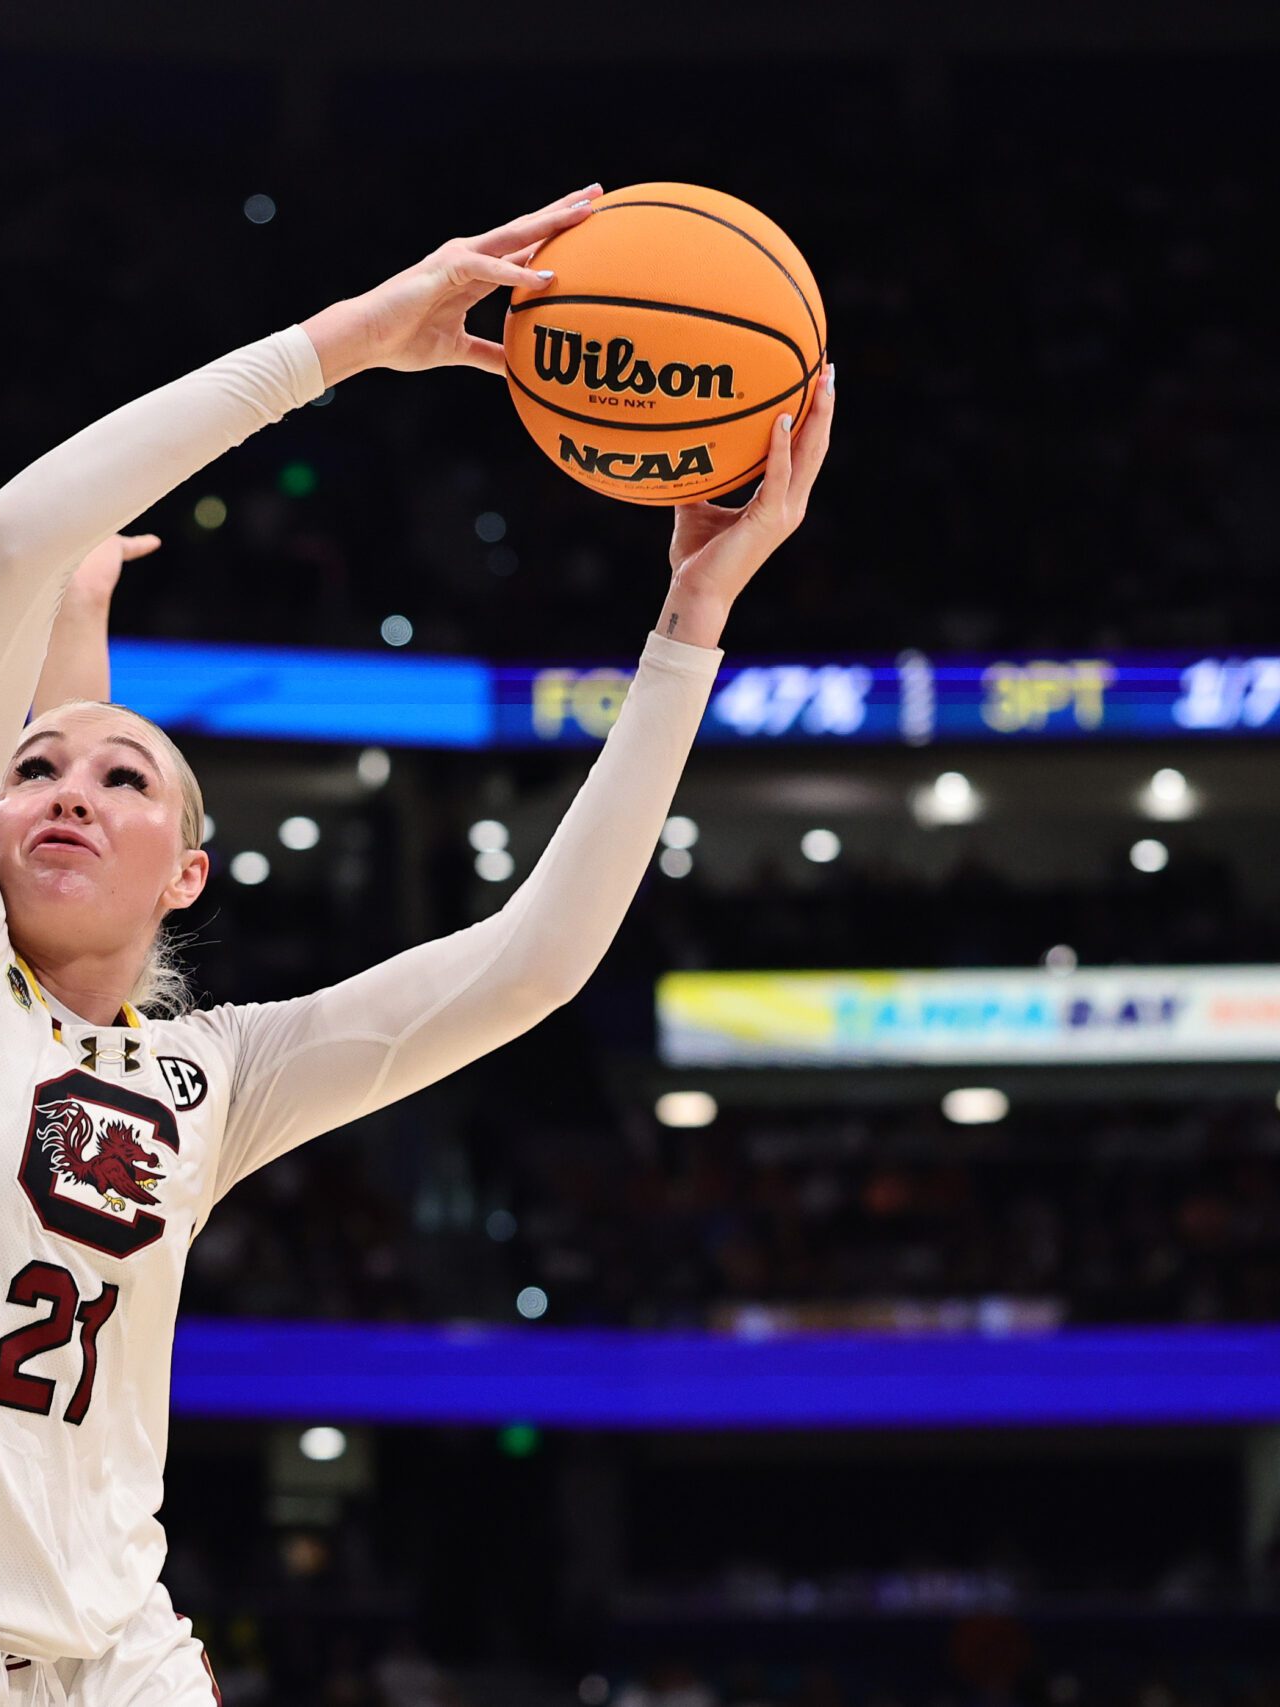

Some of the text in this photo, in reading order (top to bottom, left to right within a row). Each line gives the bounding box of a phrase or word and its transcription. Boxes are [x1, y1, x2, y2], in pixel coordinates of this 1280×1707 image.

[533, 323, 735, 399] Wilson
[588, 394, 656, 409] EVO NXT
[558, 433, 714, 482] NCAA
[980, 659, 1117, 734] 3PT
[160, 1059, 203, 1106] EC
